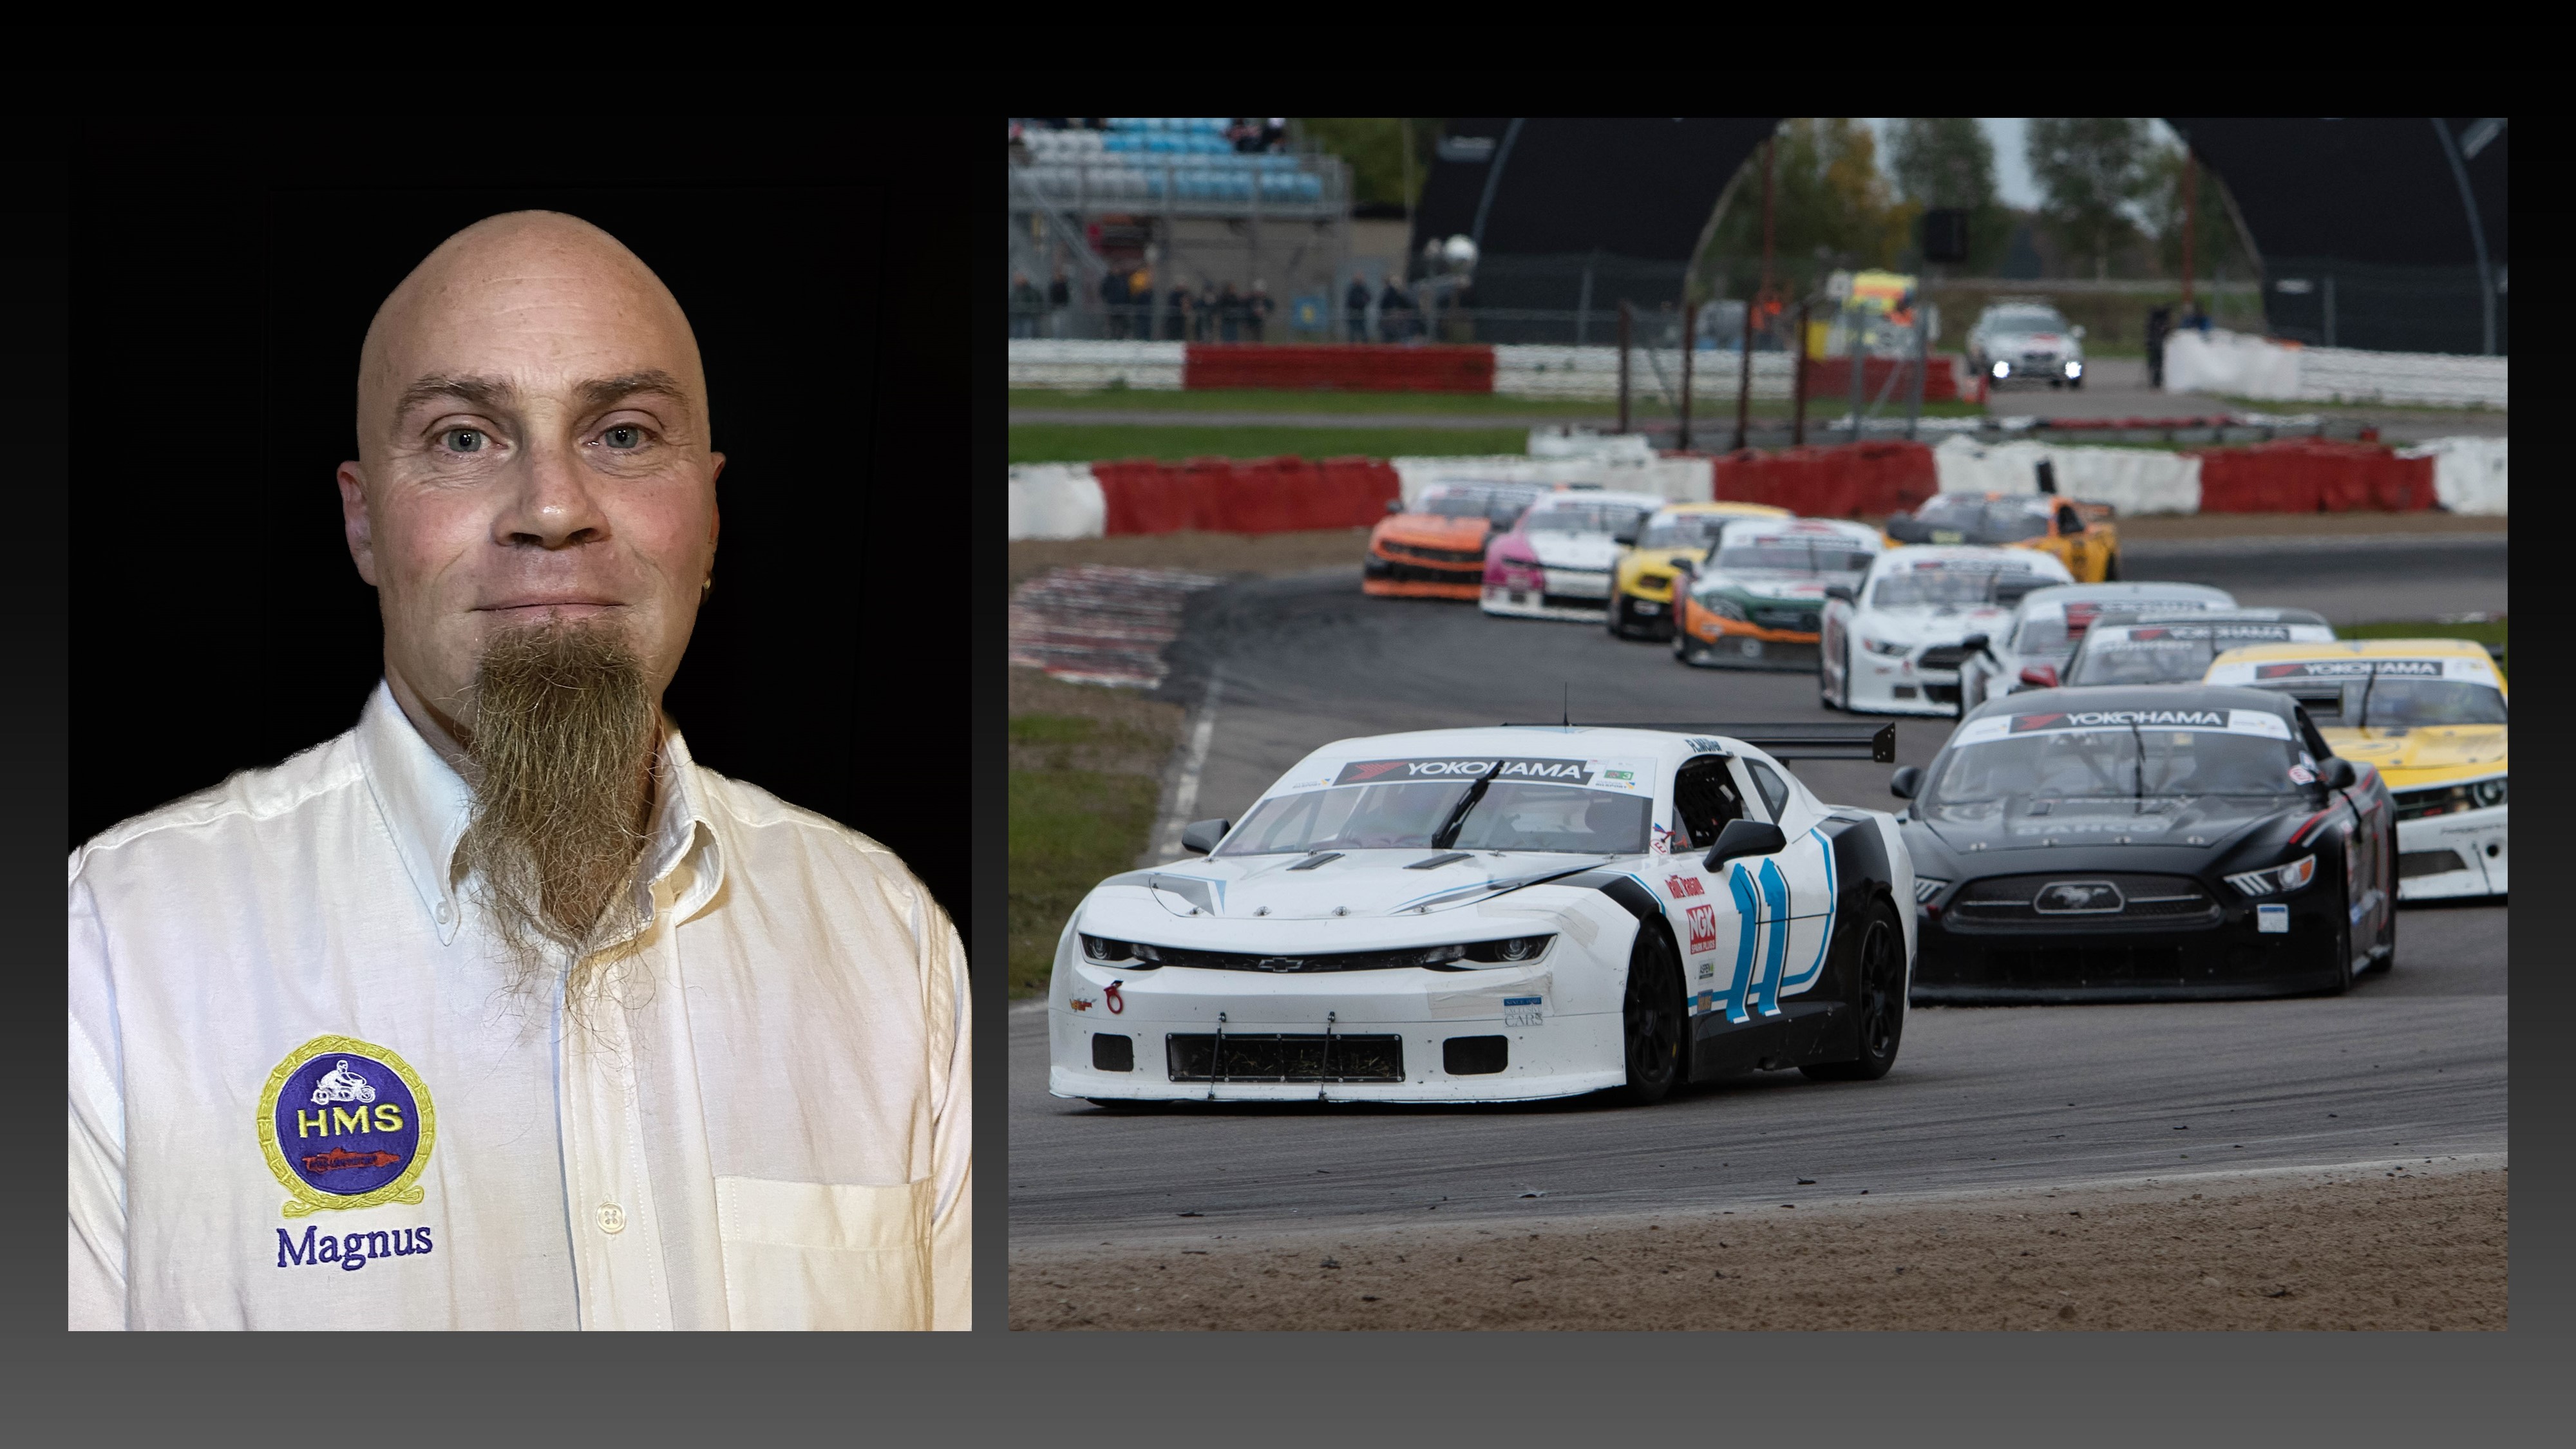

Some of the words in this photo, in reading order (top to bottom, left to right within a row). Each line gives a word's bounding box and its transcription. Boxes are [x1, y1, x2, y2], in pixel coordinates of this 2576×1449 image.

[2067, 710, 2222, 726] YOKOHAMA
[1407, 761, 1582, 779] YOKOHAMA
[1687, 905, 1715, 941] NGK
[1691, 942, 1703, 954] SPARK
[1703, 940, 1715, 951] PLUGS
[1725, 857, 1791, 1024] 11
[1504, 1012, 1543, 1028] CARS
[296, 1103, 404, 1139] HMS
[276, 1225, 433, 1272] Magnus
